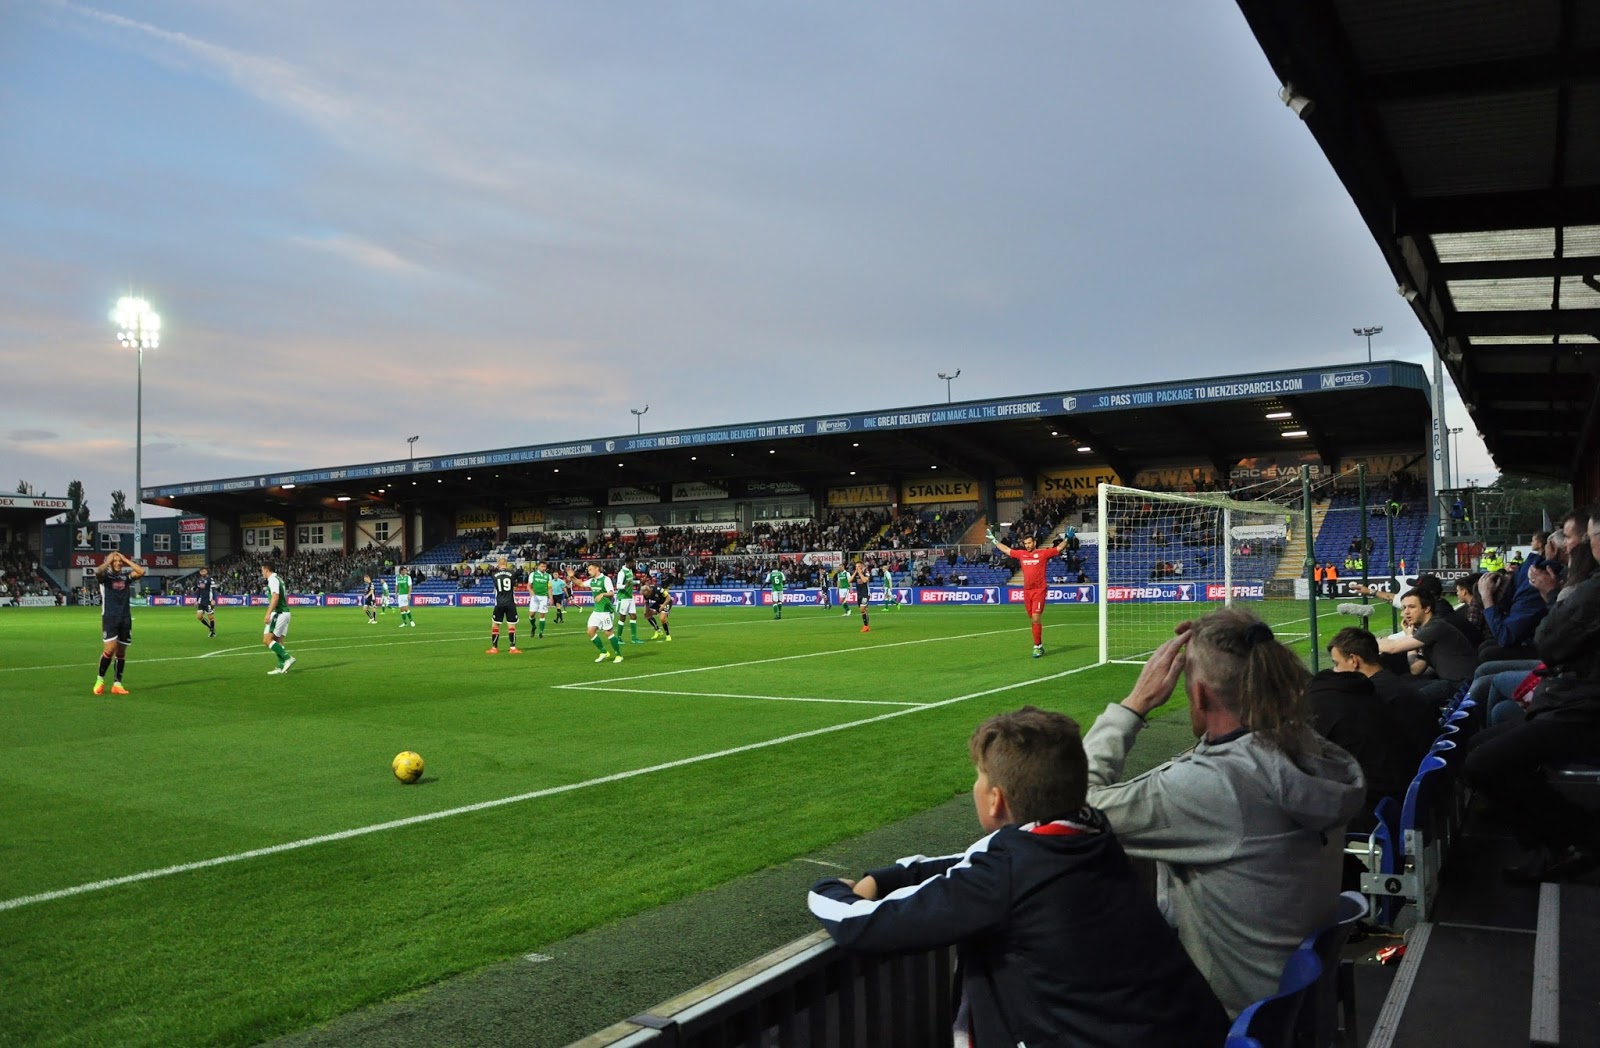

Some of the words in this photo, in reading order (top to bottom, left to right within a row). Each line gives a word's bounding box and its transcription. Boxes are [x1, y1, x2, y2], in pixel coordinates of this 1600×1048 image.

[1322, 374, 1365, 388] Menzies
[1110, 394, 1131, 406] PASS
[1131, 392, 1153, 404] YOUR
[1156, 388, 1194, 402] PACKAGE
[1195, 387, 1205, 399] TO
[1207, 378, 1303, 398] MENZIESPARCELS.COM
[863, 418, 877, 428] ONE
[877, 416, 898, 427] GREAT
[899, 413, 931, 425] DELIVERY
[932, 411, 946, 422] CAN
[947, 409, 967, 421] MAKE
[968, 408, 981, 419] ALL
[982, 406, 997, 417] THE
[817, 419, 847, 432] Menzies
[636, 438, 657, 448] THERE'S
[658, 437, 666, 446] NO
[666, 436, 680, 446] NEED
[681, 434, 691, 444] FOR
[692, 433, 706, 443] YOUR
[706, 430, 729, 442] CRUCIAL
[730, 428, 757, 440] DELIVERY
[758, 427, 766, 437] TO
[766, 426, 776, 436] HIT
[777, 425, 789, 435] THE
[789, 423, 805, 434] POST
[454, 458, 468, 467] RAISED
[469, 457, 477, 465] THE
[477, 456, 486, 464] BAR
[493, 453, 510, 462] SERVICE
[510, 452, 520, 460] AND
[520, 451, 535, 460] VALUE
[535, 450, 541, 458] AT
[1044, 475, 1116, 492] STANLEY
[908, 482, 972, 498] STANLEY
[33, 500, 67, 508] WELDEX
[459, 512, 497, 524] STANLEY
[497, 578, 512, 592] 19
[774, 576, 780, 584] 6
[923, 591, 970, 601] BETFRED
[1011, 590, 1062, 600] BEED
[1107, 588, 1161, 599] BETFRED
[1162, 590, 1176, 598] CUP
[1209, 586, 1263, 597] BEFRE
[414, 596, 440, 604] BETFRED
[462, 596, 490, 604] BETFRED
[694, 593, 732, 603] BETFRED
[764, 593, 806, 603] BFRED
[806, 595, 817, 603] CUP
[1390, 881, 1397, 890] A
